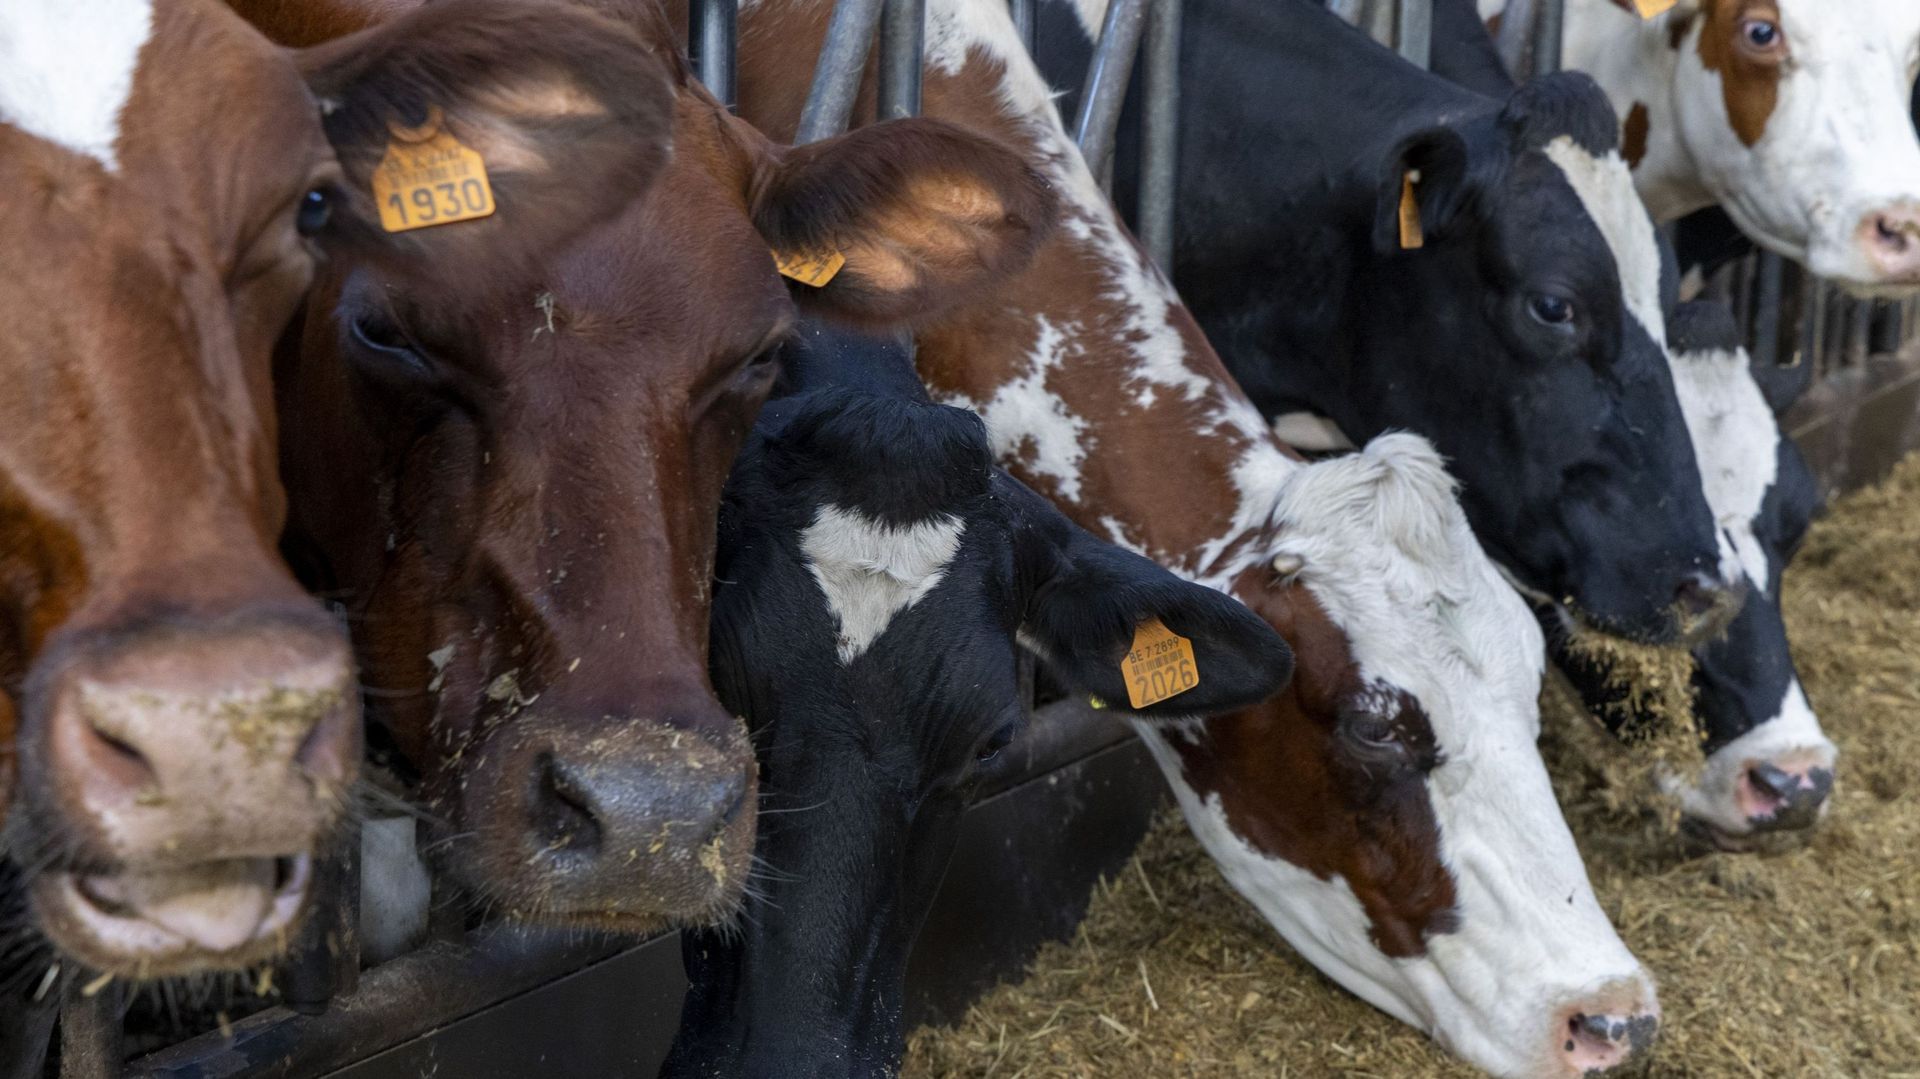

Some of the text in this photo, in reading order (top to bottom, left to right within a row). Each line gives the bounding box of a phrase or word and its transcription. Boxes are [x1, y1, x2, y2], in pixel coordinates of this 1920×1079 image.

[389, 178, 488, 225] 1930
[1129, 650, 1144, 664] BE
[1135, 658, 1194, 705] 2026
